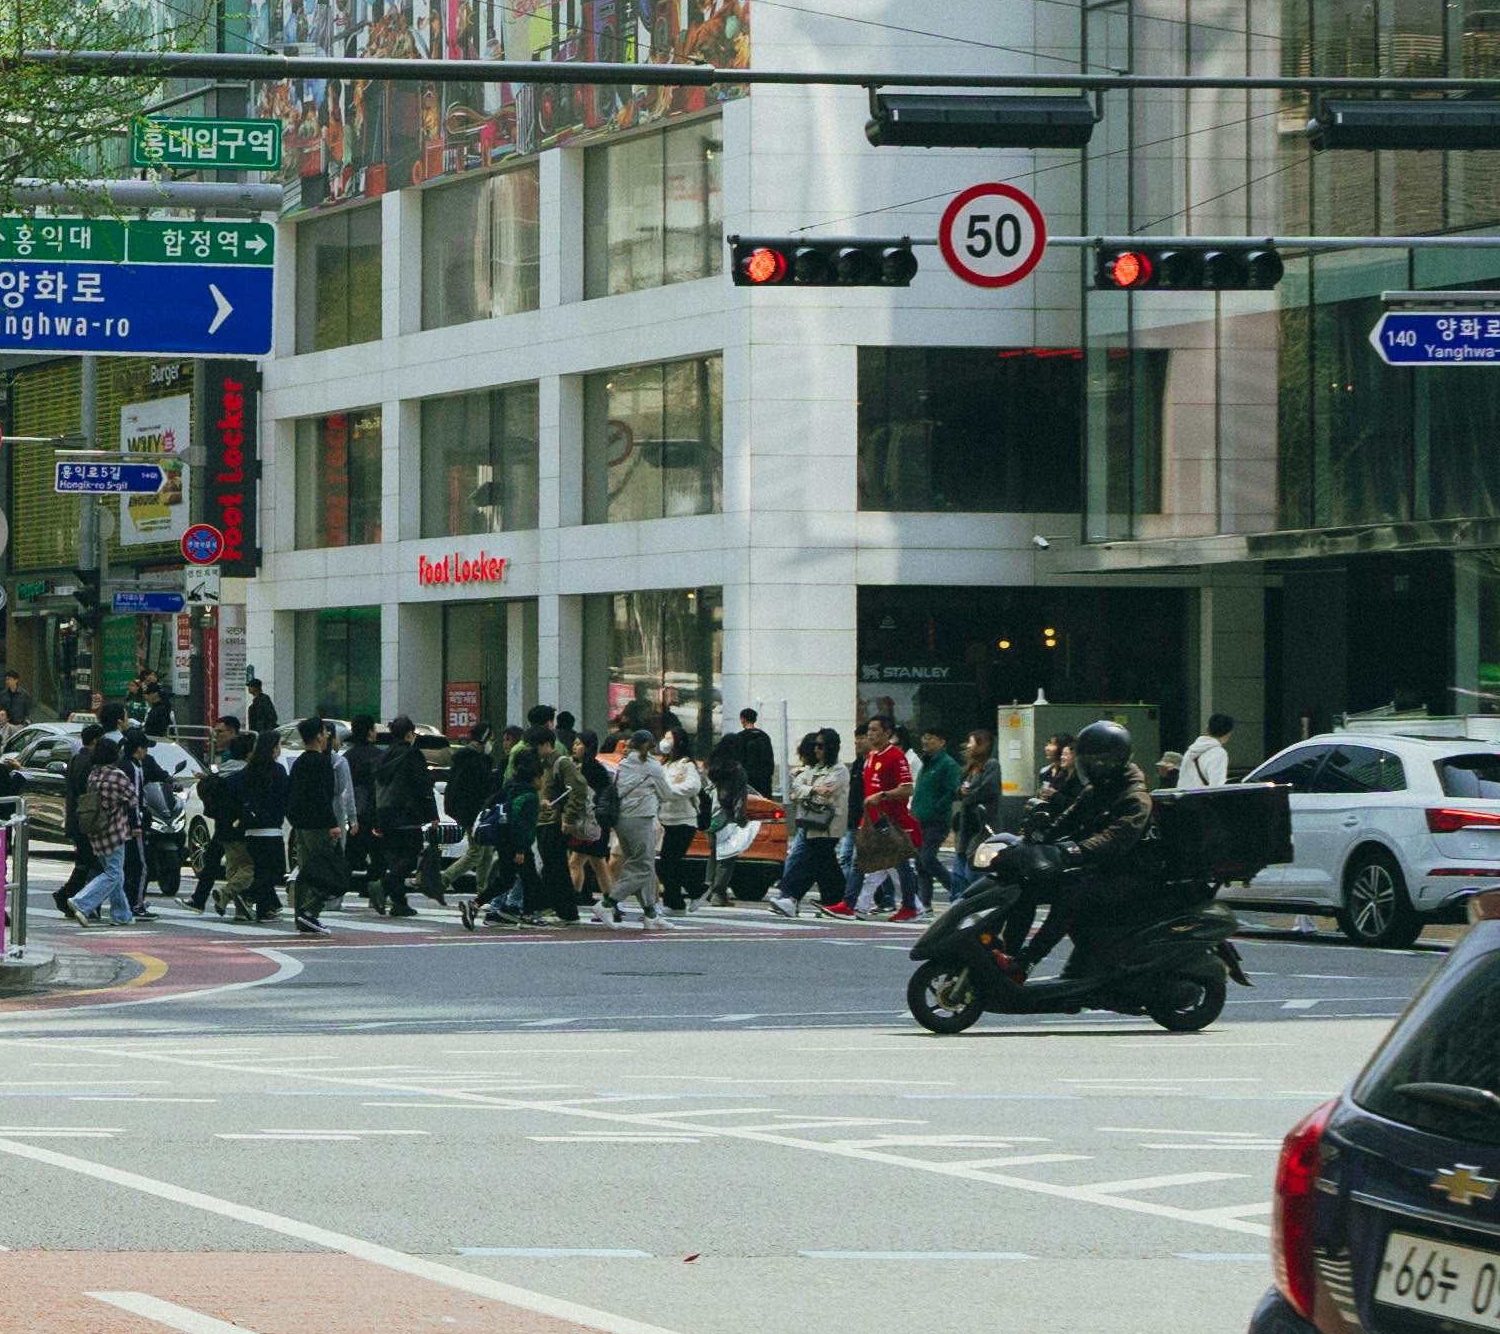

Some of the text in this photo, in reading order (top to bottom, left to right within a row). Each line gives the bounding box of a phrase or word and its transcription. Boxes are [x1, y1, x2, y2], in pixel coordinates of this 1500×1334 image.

[139, 126, 274, 161] 홍대입구역
[11, 225, 92, 255] 홍익대
[162, 228, 239, 257] 합정역
[965, 213, 1022, 258] 50
[1386, 330, 1417, 347] 140
[1423, 344, 1500, 361] Yanghwa-
[151, 363, 180, 386] Burger
[127, 433, 163, 453] WHY
[60, 466, 121, 480] 홍익로5길
[217, 378, 244, 560] Foot Locker
[59, 480, 105, 492] Hongik-ro
[418, 550, 507, 586] Foot Locker
[883, 667, 949, 678] STANLEY
[1395, 1246, 1459, 1305] 66누
